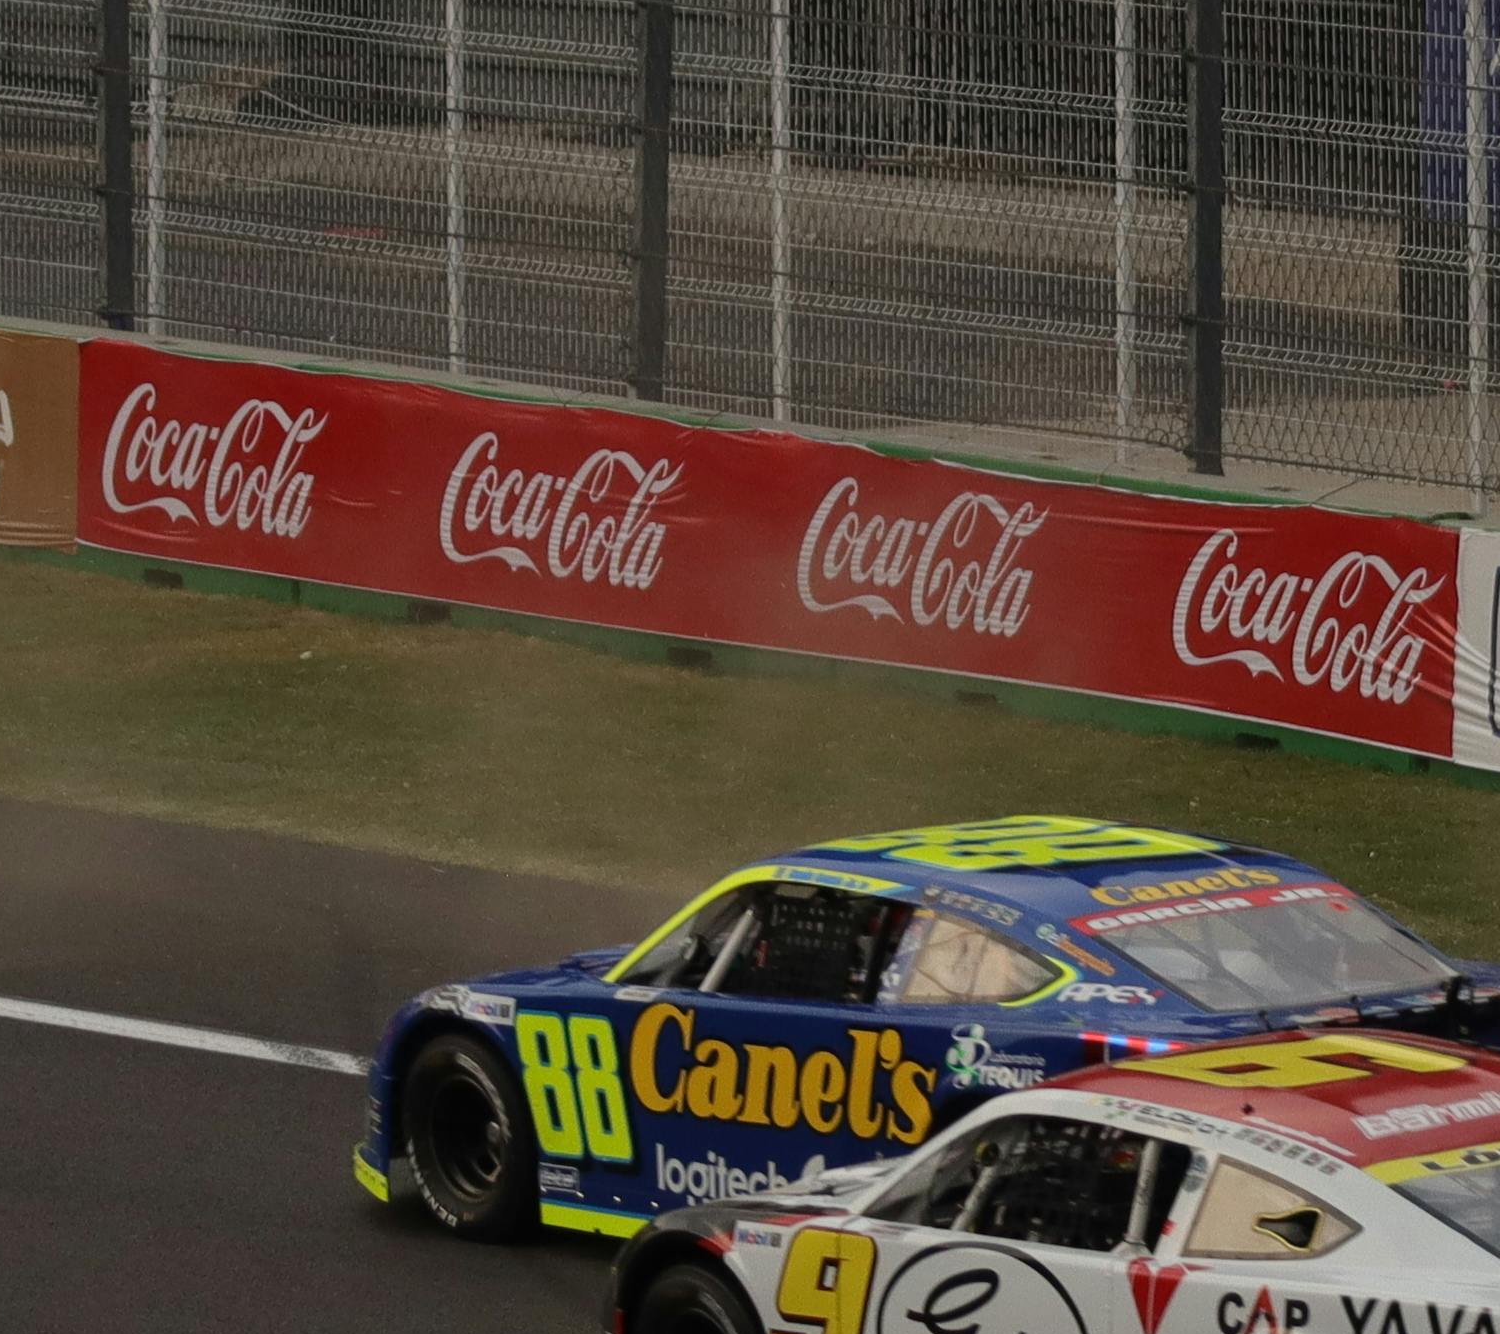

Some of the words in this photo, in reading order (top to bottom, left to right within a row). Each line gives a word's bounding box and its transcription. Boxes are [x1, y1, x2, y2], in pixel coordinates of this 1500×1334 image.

[102, 382, 329, 540] Coca-Cola
[439, 431, 685, 591] Coca-Cola
[797, 476, 1052, 639] Coca-Cola
[1171, 527, 1447, 706] Coca-Cola
[1091, 865, 1283, 907] Canel's
[515, 1009, 635, 1163] 88
[629, 1002, 938, 1146] Canel's
